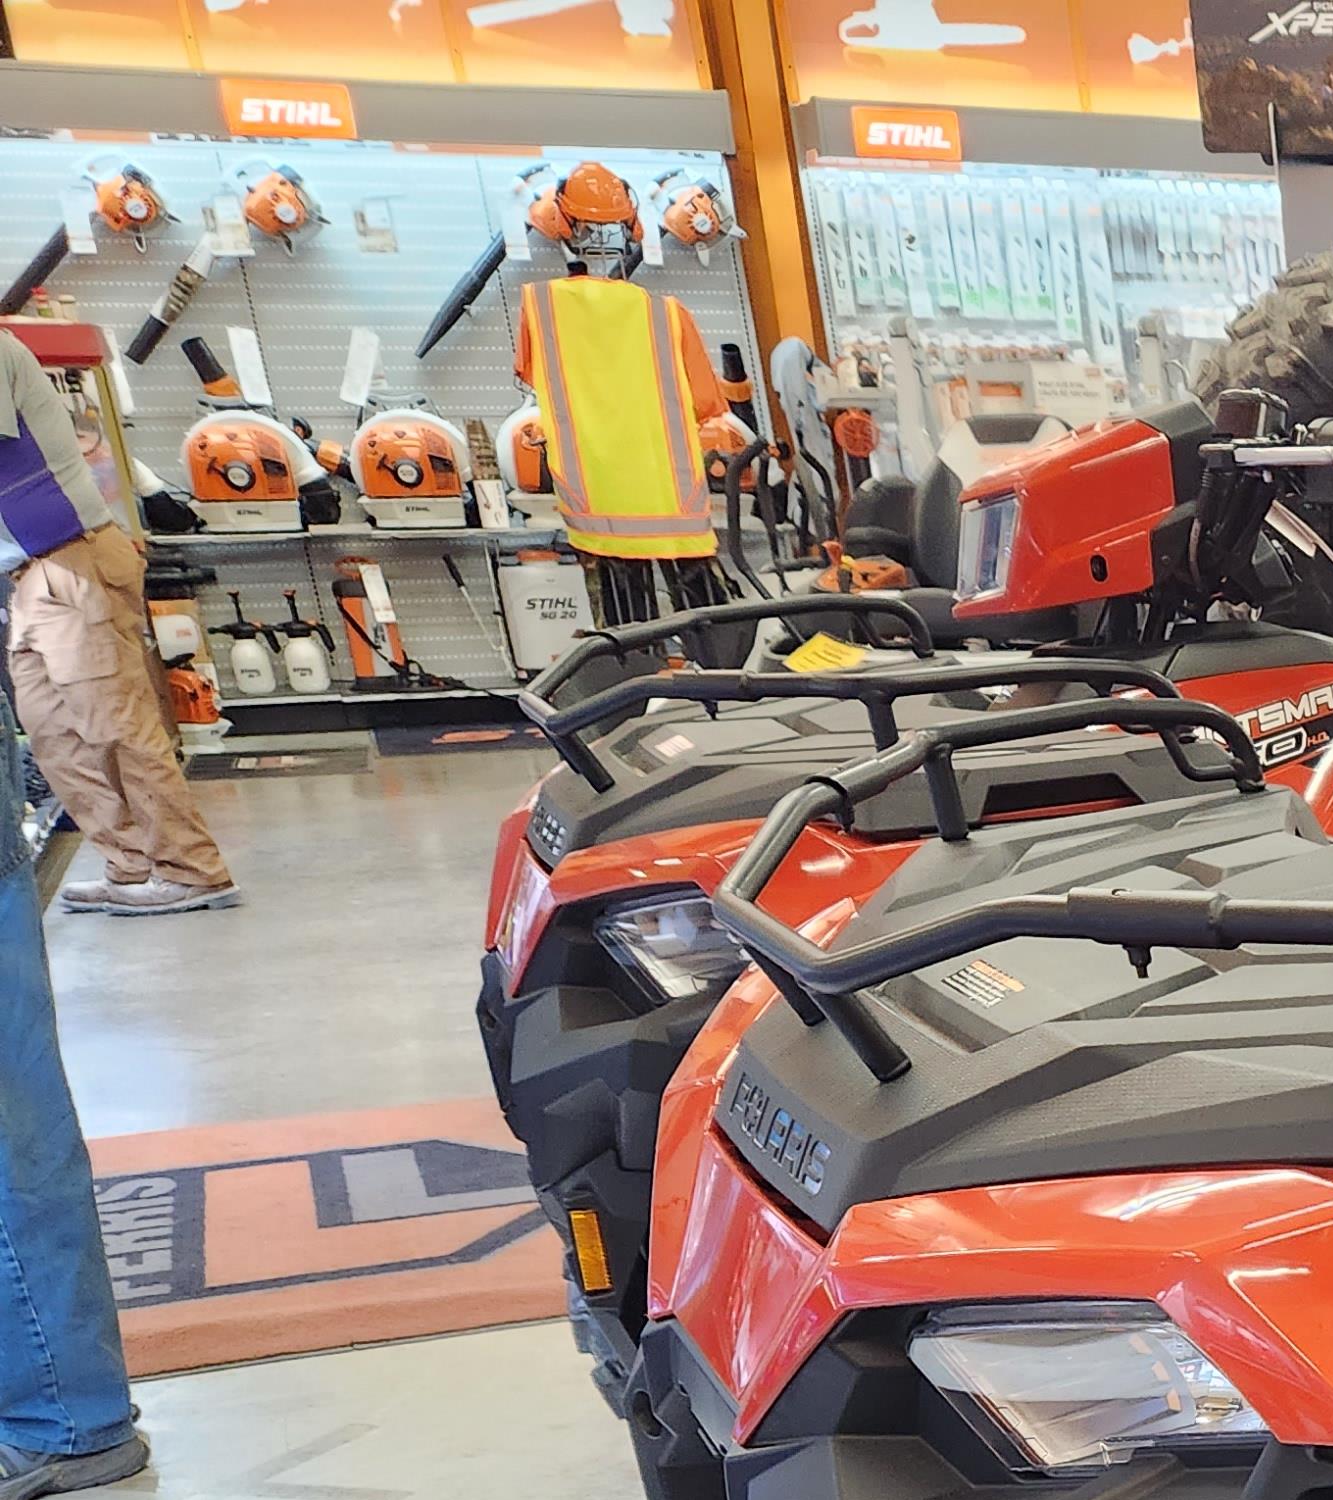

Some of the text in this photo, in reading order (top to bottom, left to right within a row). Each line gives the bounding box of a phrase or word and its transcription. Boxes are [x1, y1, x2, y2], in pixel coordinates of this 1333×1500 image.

[240, 97, 343, 127] STIHL
[867, 122, 952, 149] STIHL
[525, 597, 578, 611] STIHL
[728, 1071, 833, 1196] POLARIS
